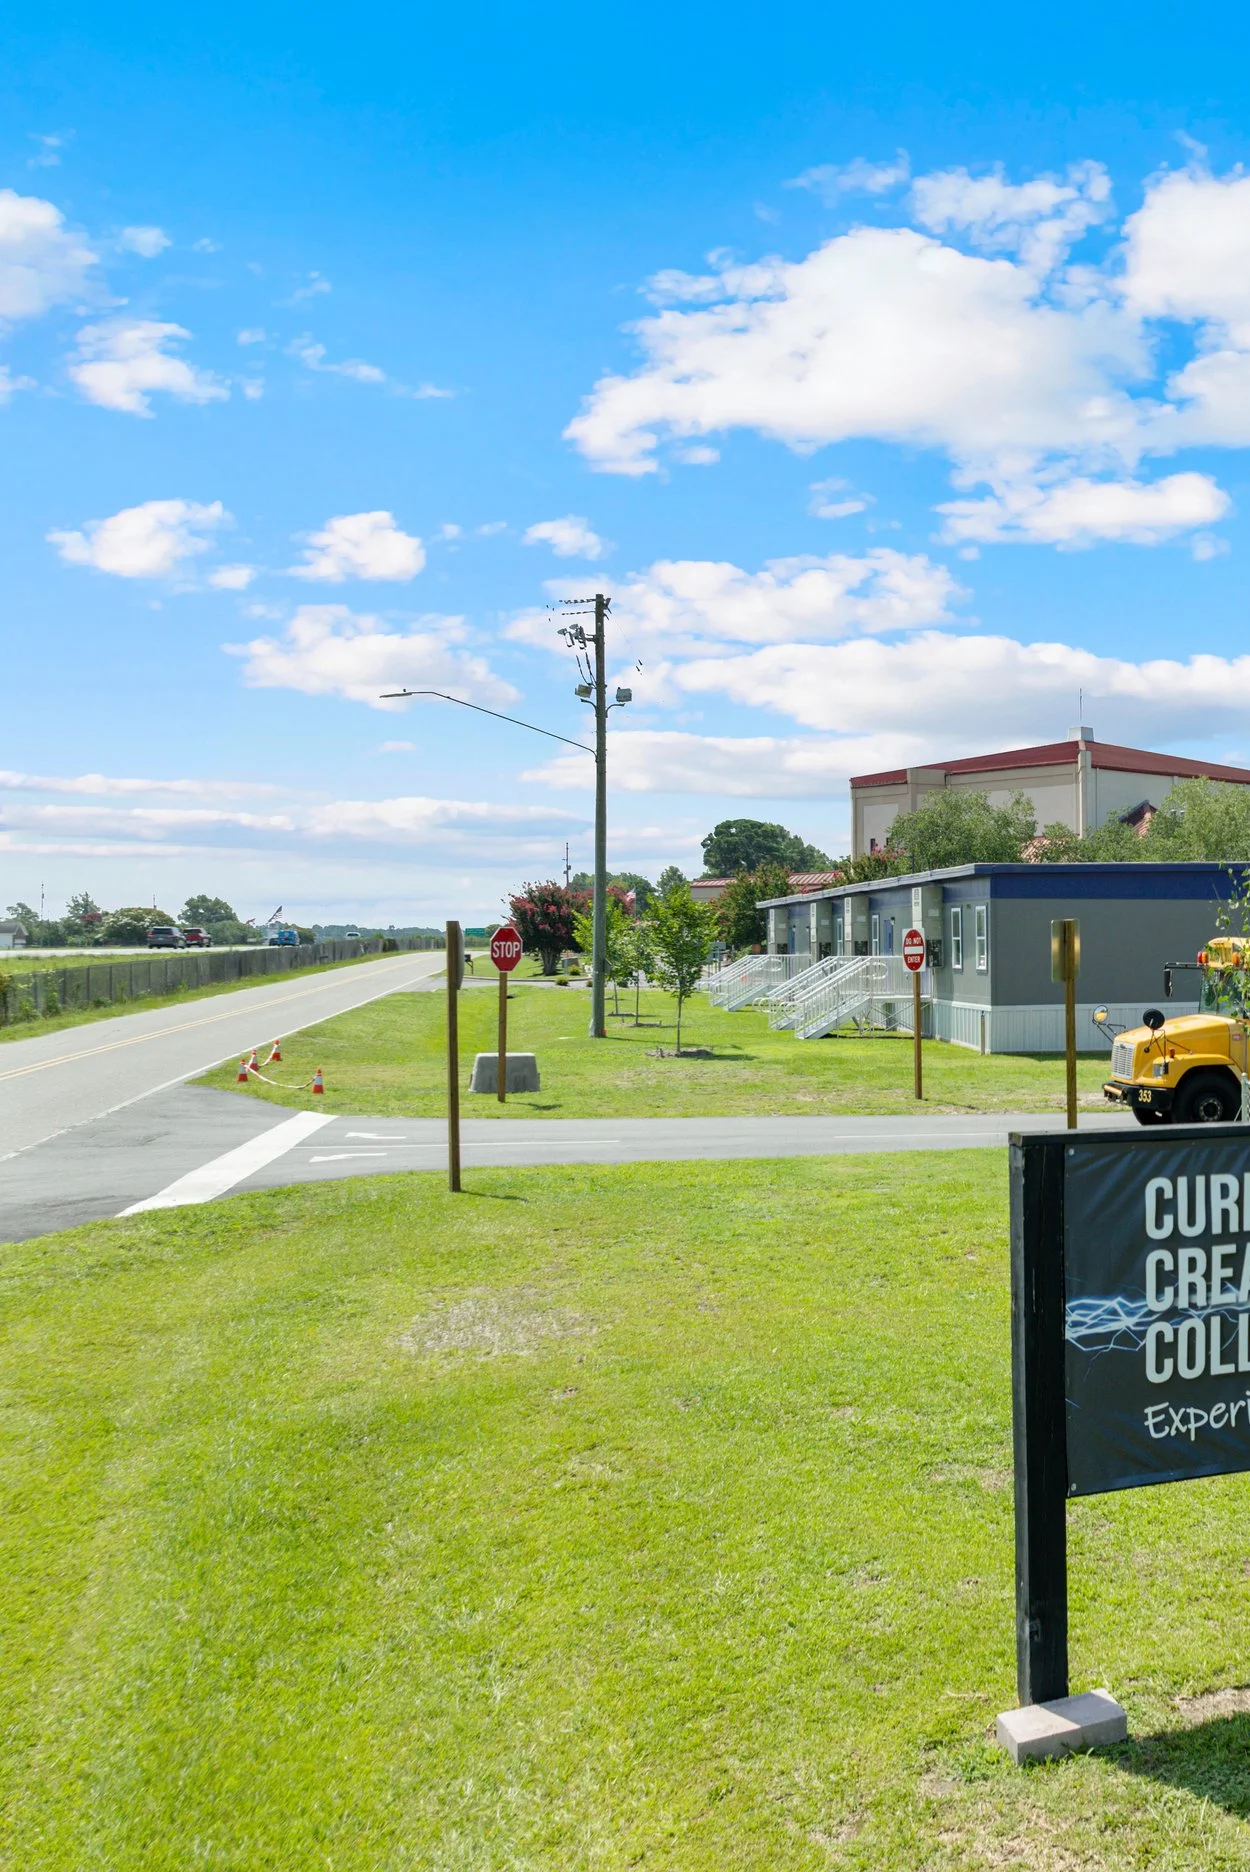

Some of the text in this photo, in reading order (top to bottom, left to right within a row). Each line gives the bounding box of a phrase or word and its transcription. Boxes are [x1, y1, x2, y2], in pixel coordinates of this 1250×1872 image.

[905, 937, 922, 945] DO NOT
[492, 941, 520, 958] STOP
[1138, 1089, 1152, 1102] 353
